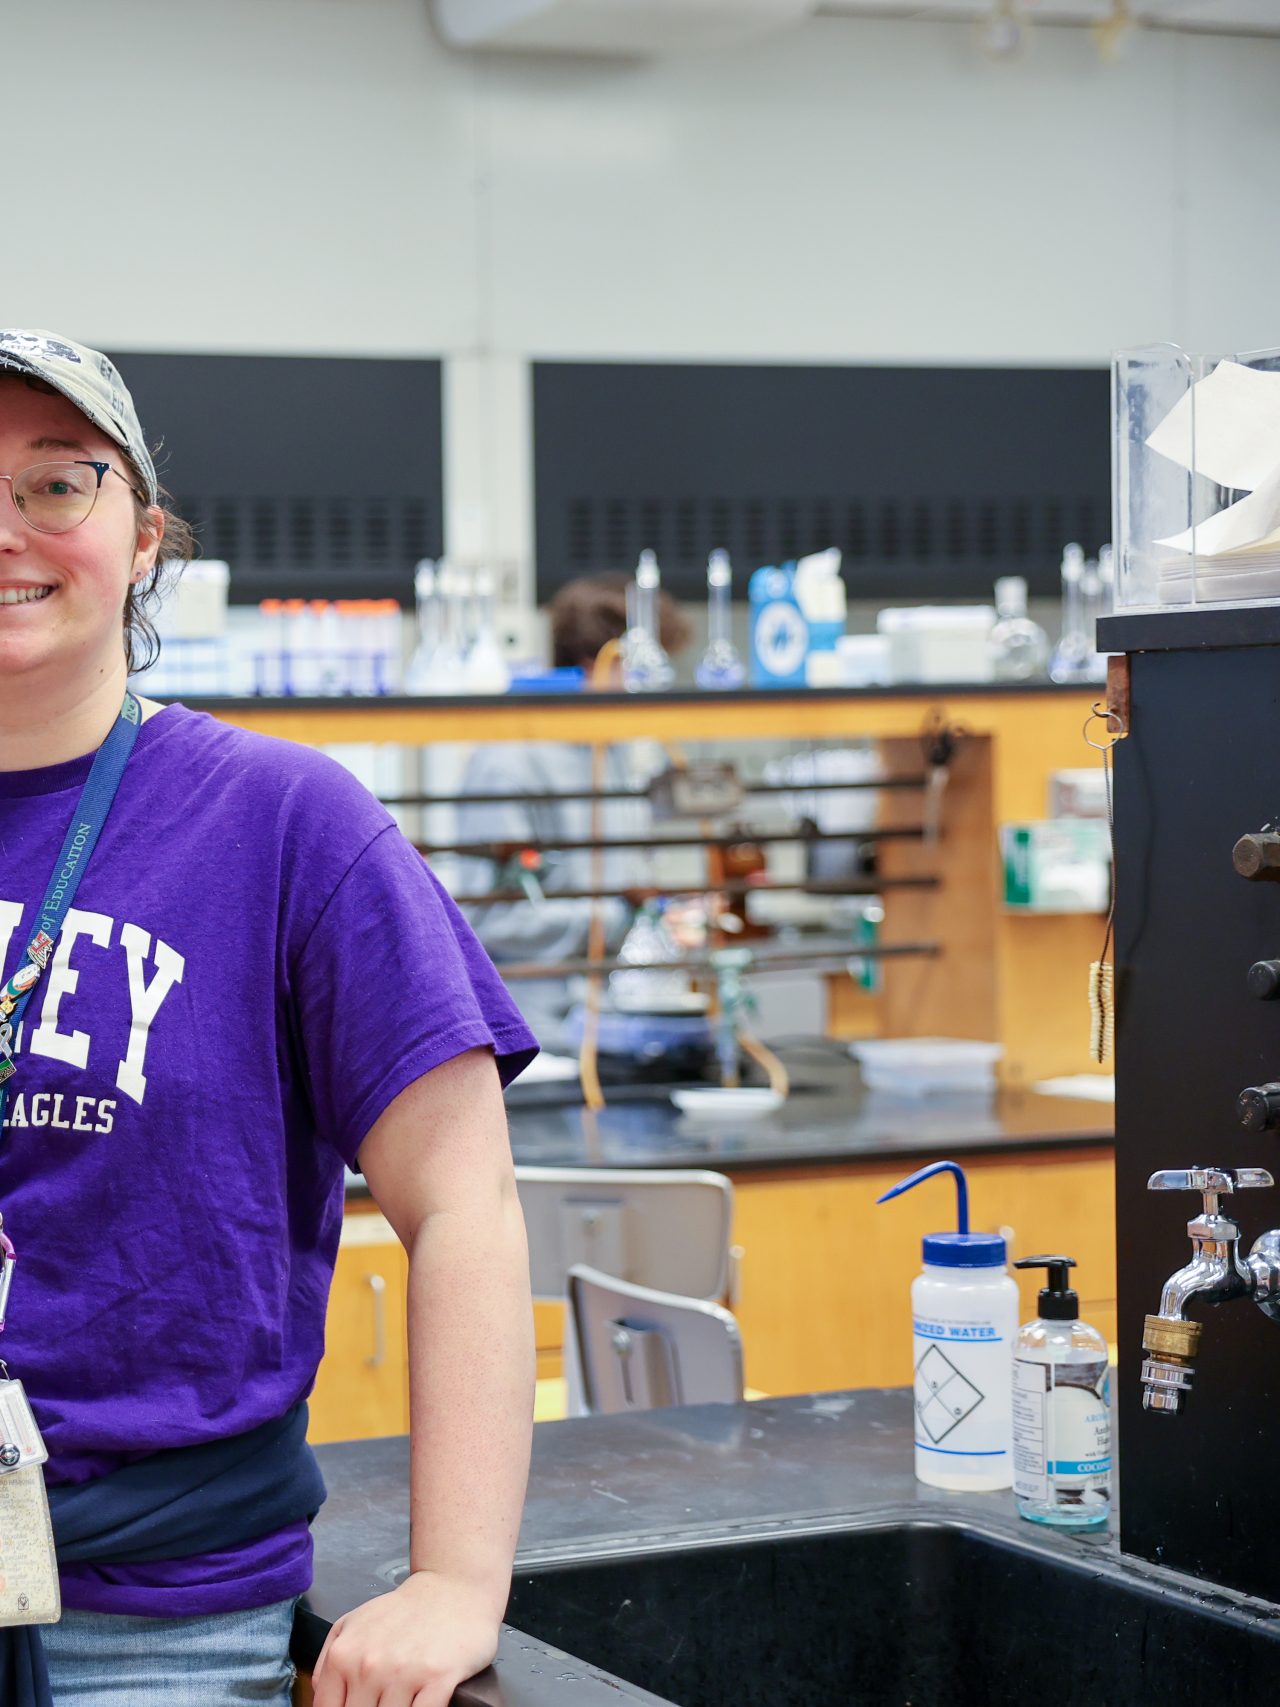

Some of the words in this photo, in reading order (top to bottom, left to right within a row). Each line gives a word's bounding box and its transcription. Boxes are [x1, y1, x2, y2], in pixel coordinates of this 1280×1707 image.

[44, 822, 92, 912] EDUCATION
[40, 914, 56, 931] of
[3, 1093, 117, 1135] AGLES
[948, 1326, 996, 1338] WATER
